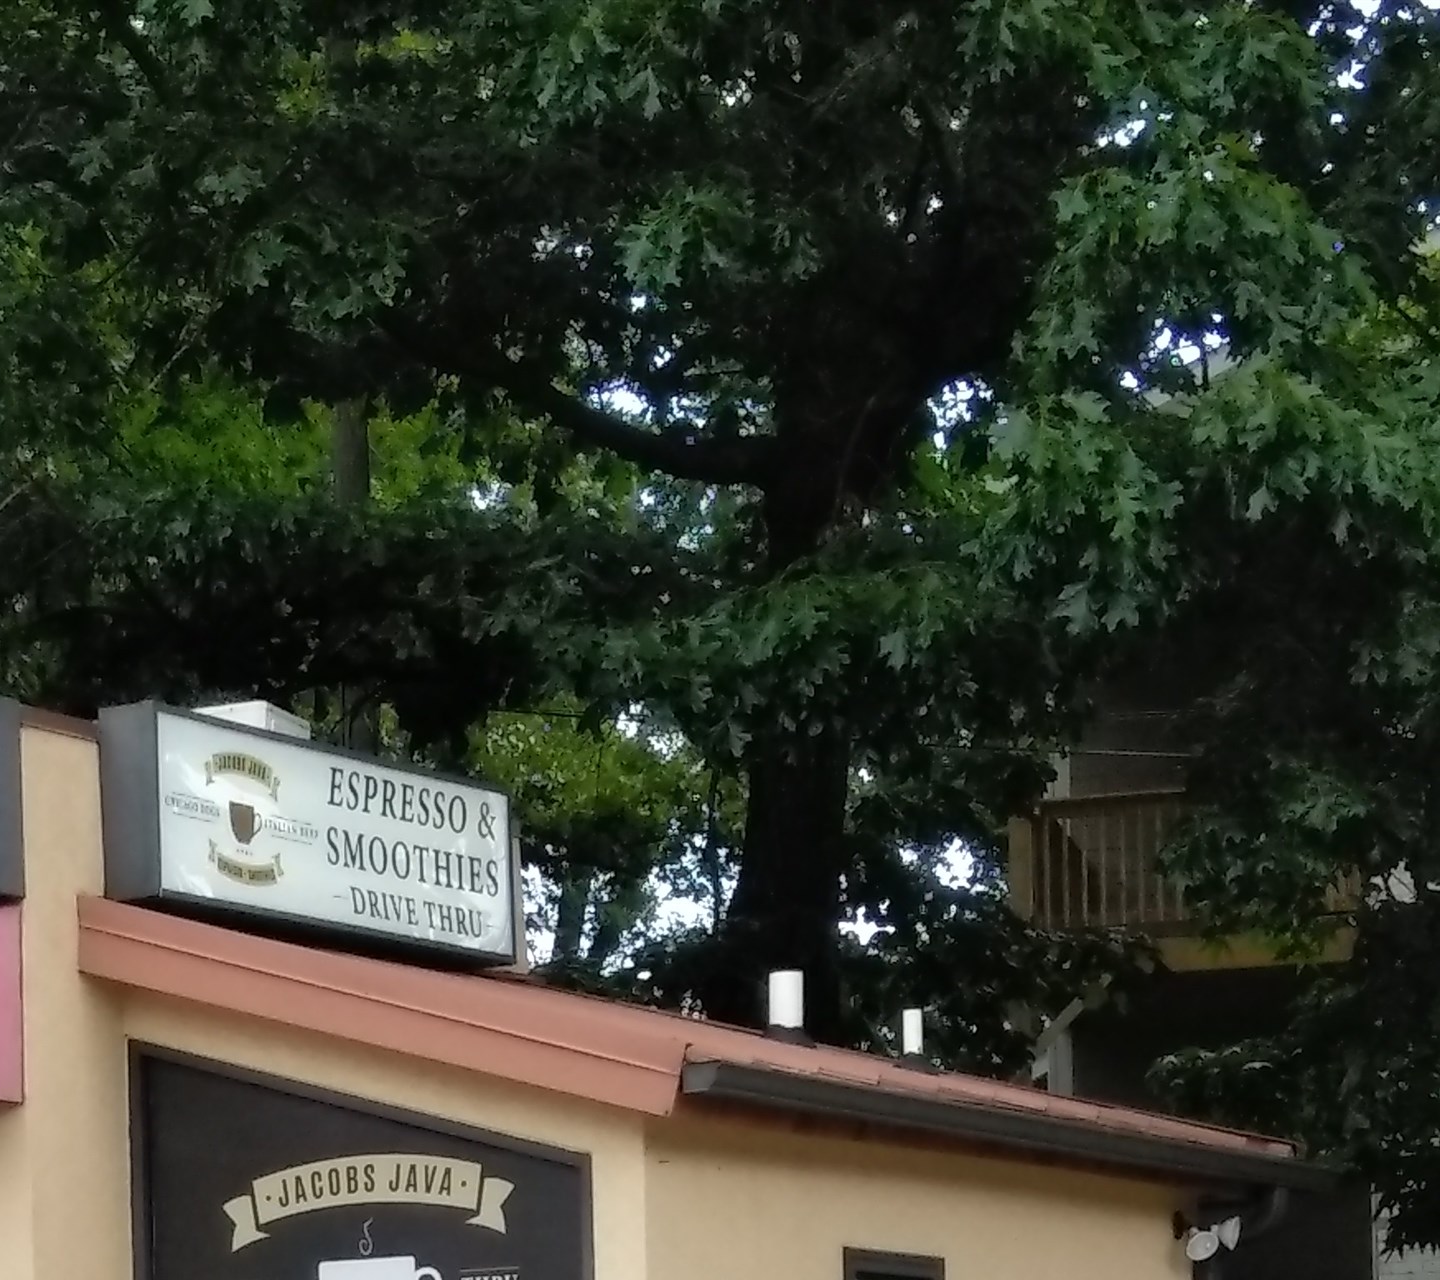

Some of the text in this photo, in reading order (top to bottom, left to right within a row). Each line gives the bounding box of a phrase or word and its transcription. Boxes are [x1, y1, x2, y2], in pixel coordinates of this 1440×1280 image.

[326, 766, 467, 835] ESPRESSO
[477, 801, 497, 842] &
[326, 826, 500, 898] SMOOTHIES
[349, 886, 484, 939] DRIVE THRU
[277, 1162, 453, 1208] JACOBS JAVA
